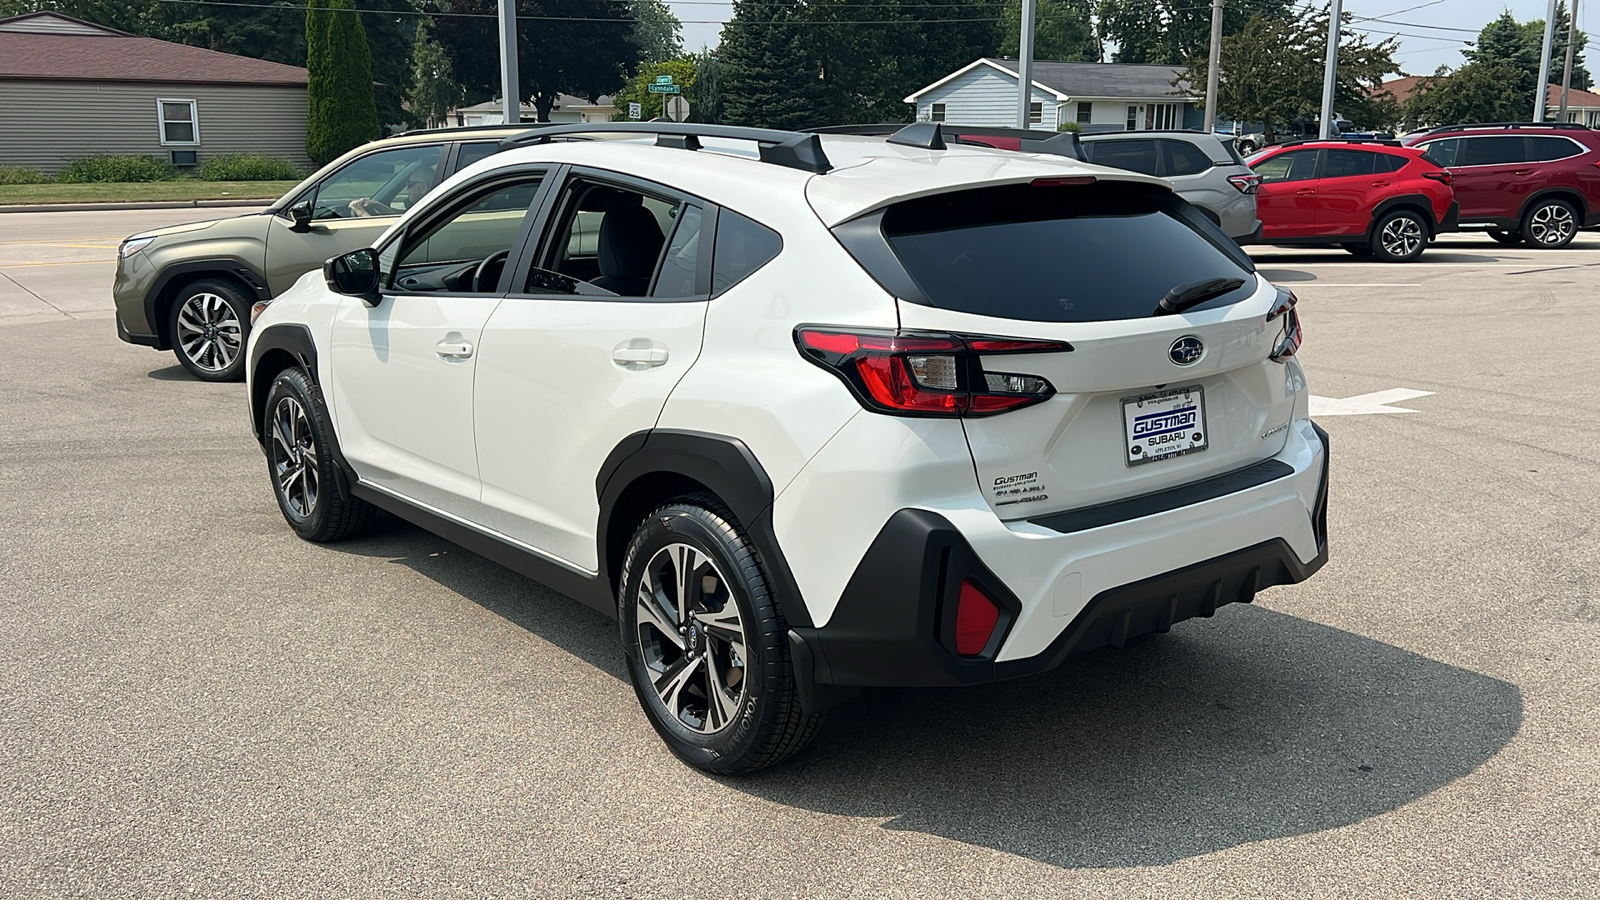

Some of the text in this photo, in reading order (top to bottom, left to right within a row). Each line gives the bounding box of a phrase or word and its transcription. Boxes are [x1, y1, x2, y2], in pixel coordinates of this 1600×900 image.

[1148, 431, 1185, 446] SUBARU
[1018, 494, 1048, 504] AWD
[619, 527, 649, 625] OLANDAR
[720, 695, 758, 754] YOKOHAMA
